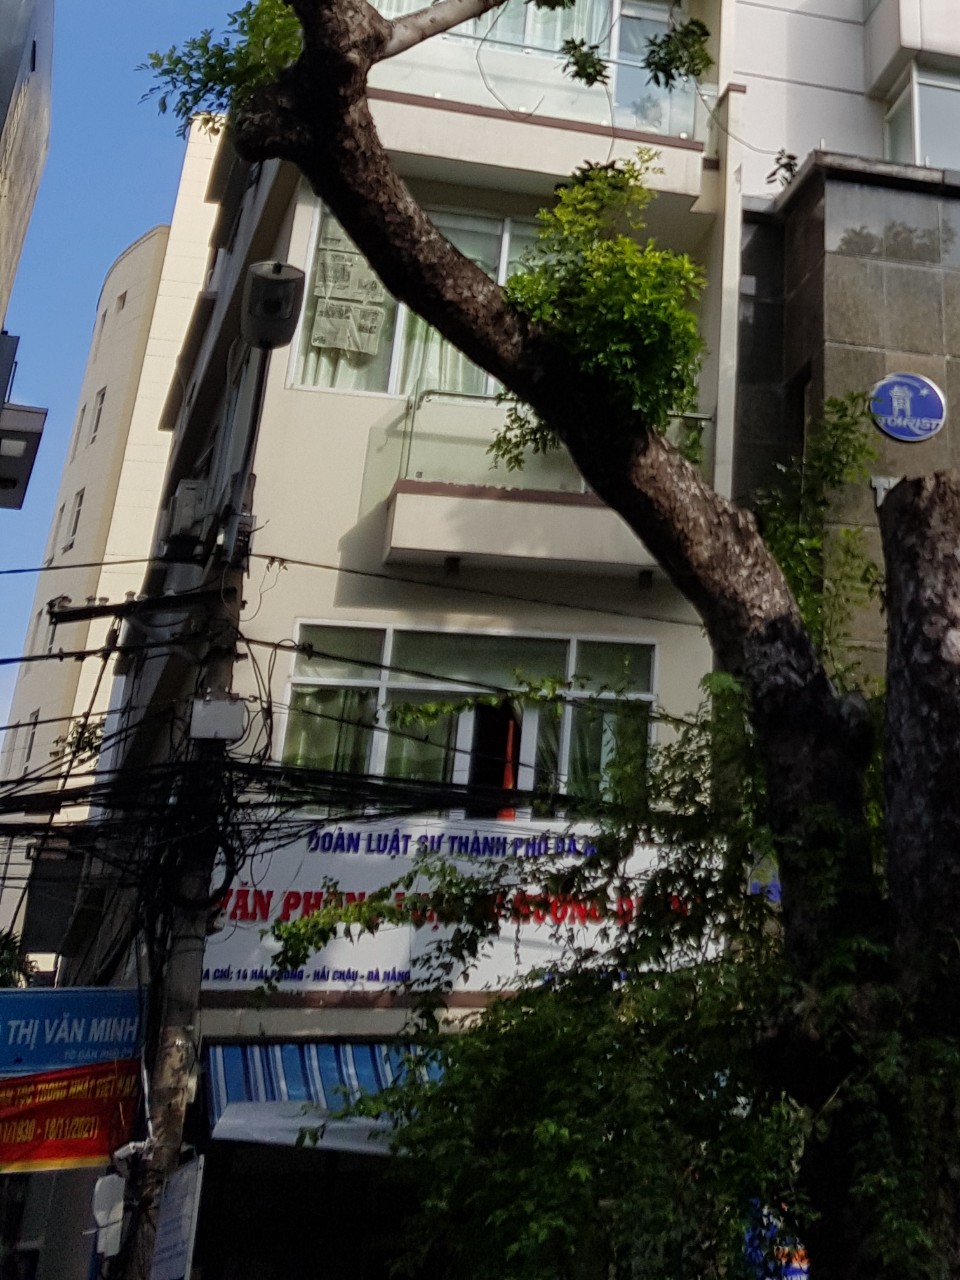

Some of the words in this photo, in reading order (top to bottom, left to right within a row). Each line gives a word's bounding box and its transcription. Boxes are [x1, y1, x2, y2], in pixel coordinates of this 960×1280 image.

[365, 828, 412, 860] LUẬT
[449, 830, 507, 857] THÀNH
[8, 1019, 39, 1050] THỊ
[44, 1012, 85, 1044] VĂN
[88, 1017, 139, 1043] MINH
